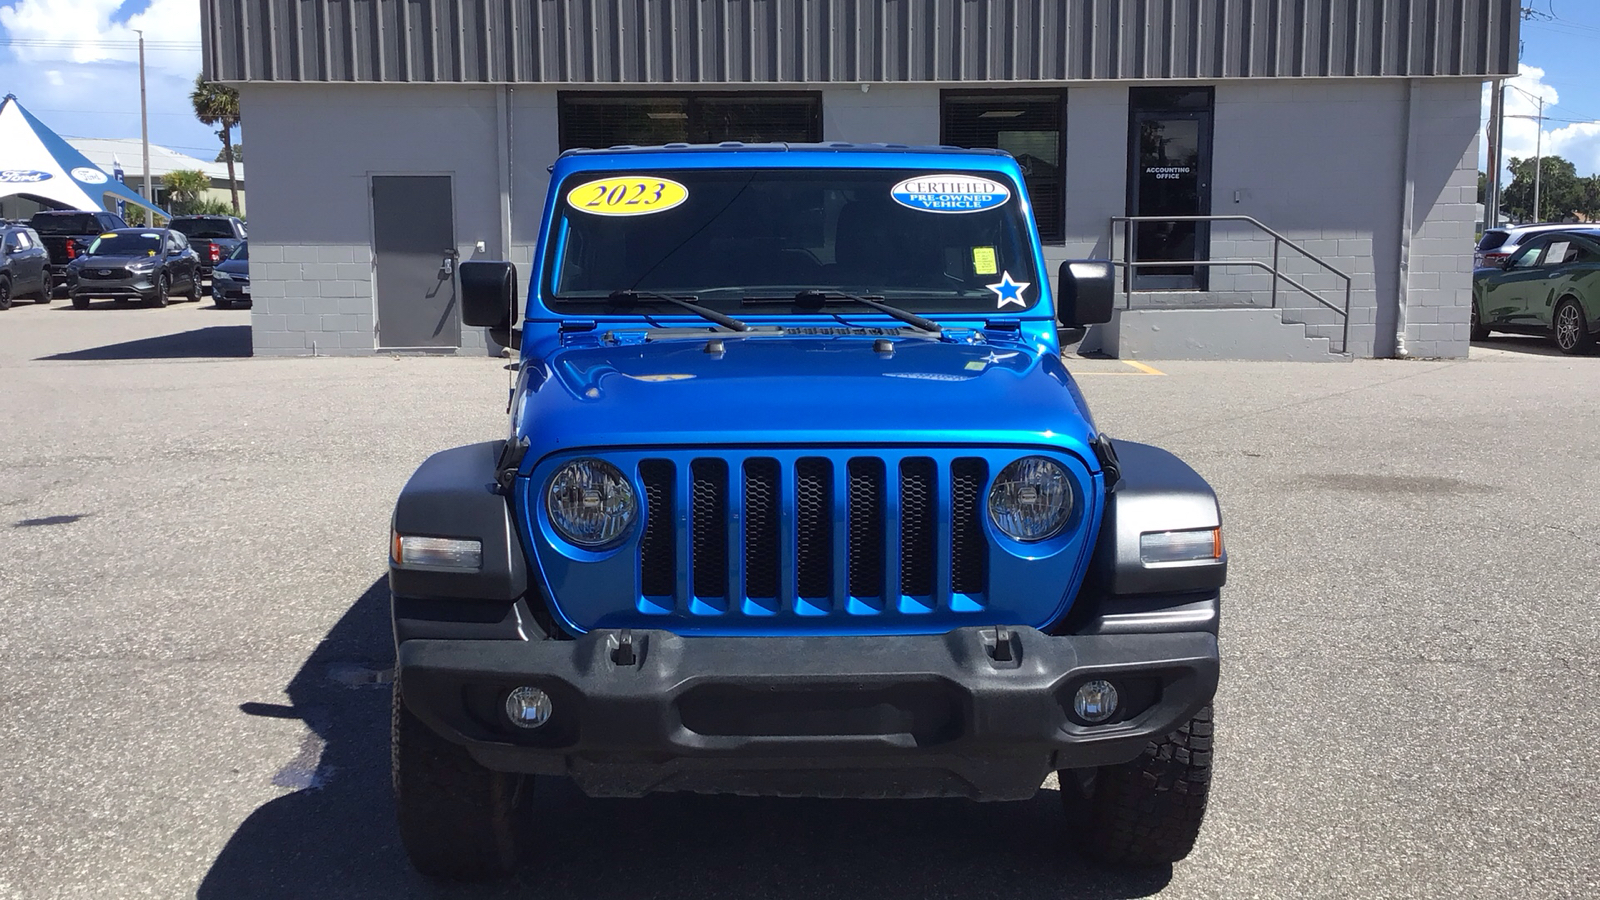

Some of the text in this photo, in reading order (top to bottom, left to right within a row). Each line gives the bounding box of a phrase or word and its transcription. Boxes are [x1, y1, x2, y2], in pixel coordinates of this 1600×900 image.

[0, 170, 42, 181] Ford
[905, 182, 995, 193] CERTIFIED
[585, 183, 666, 207] 2023
[910, 194, 992, 202] PRE-OWNED
